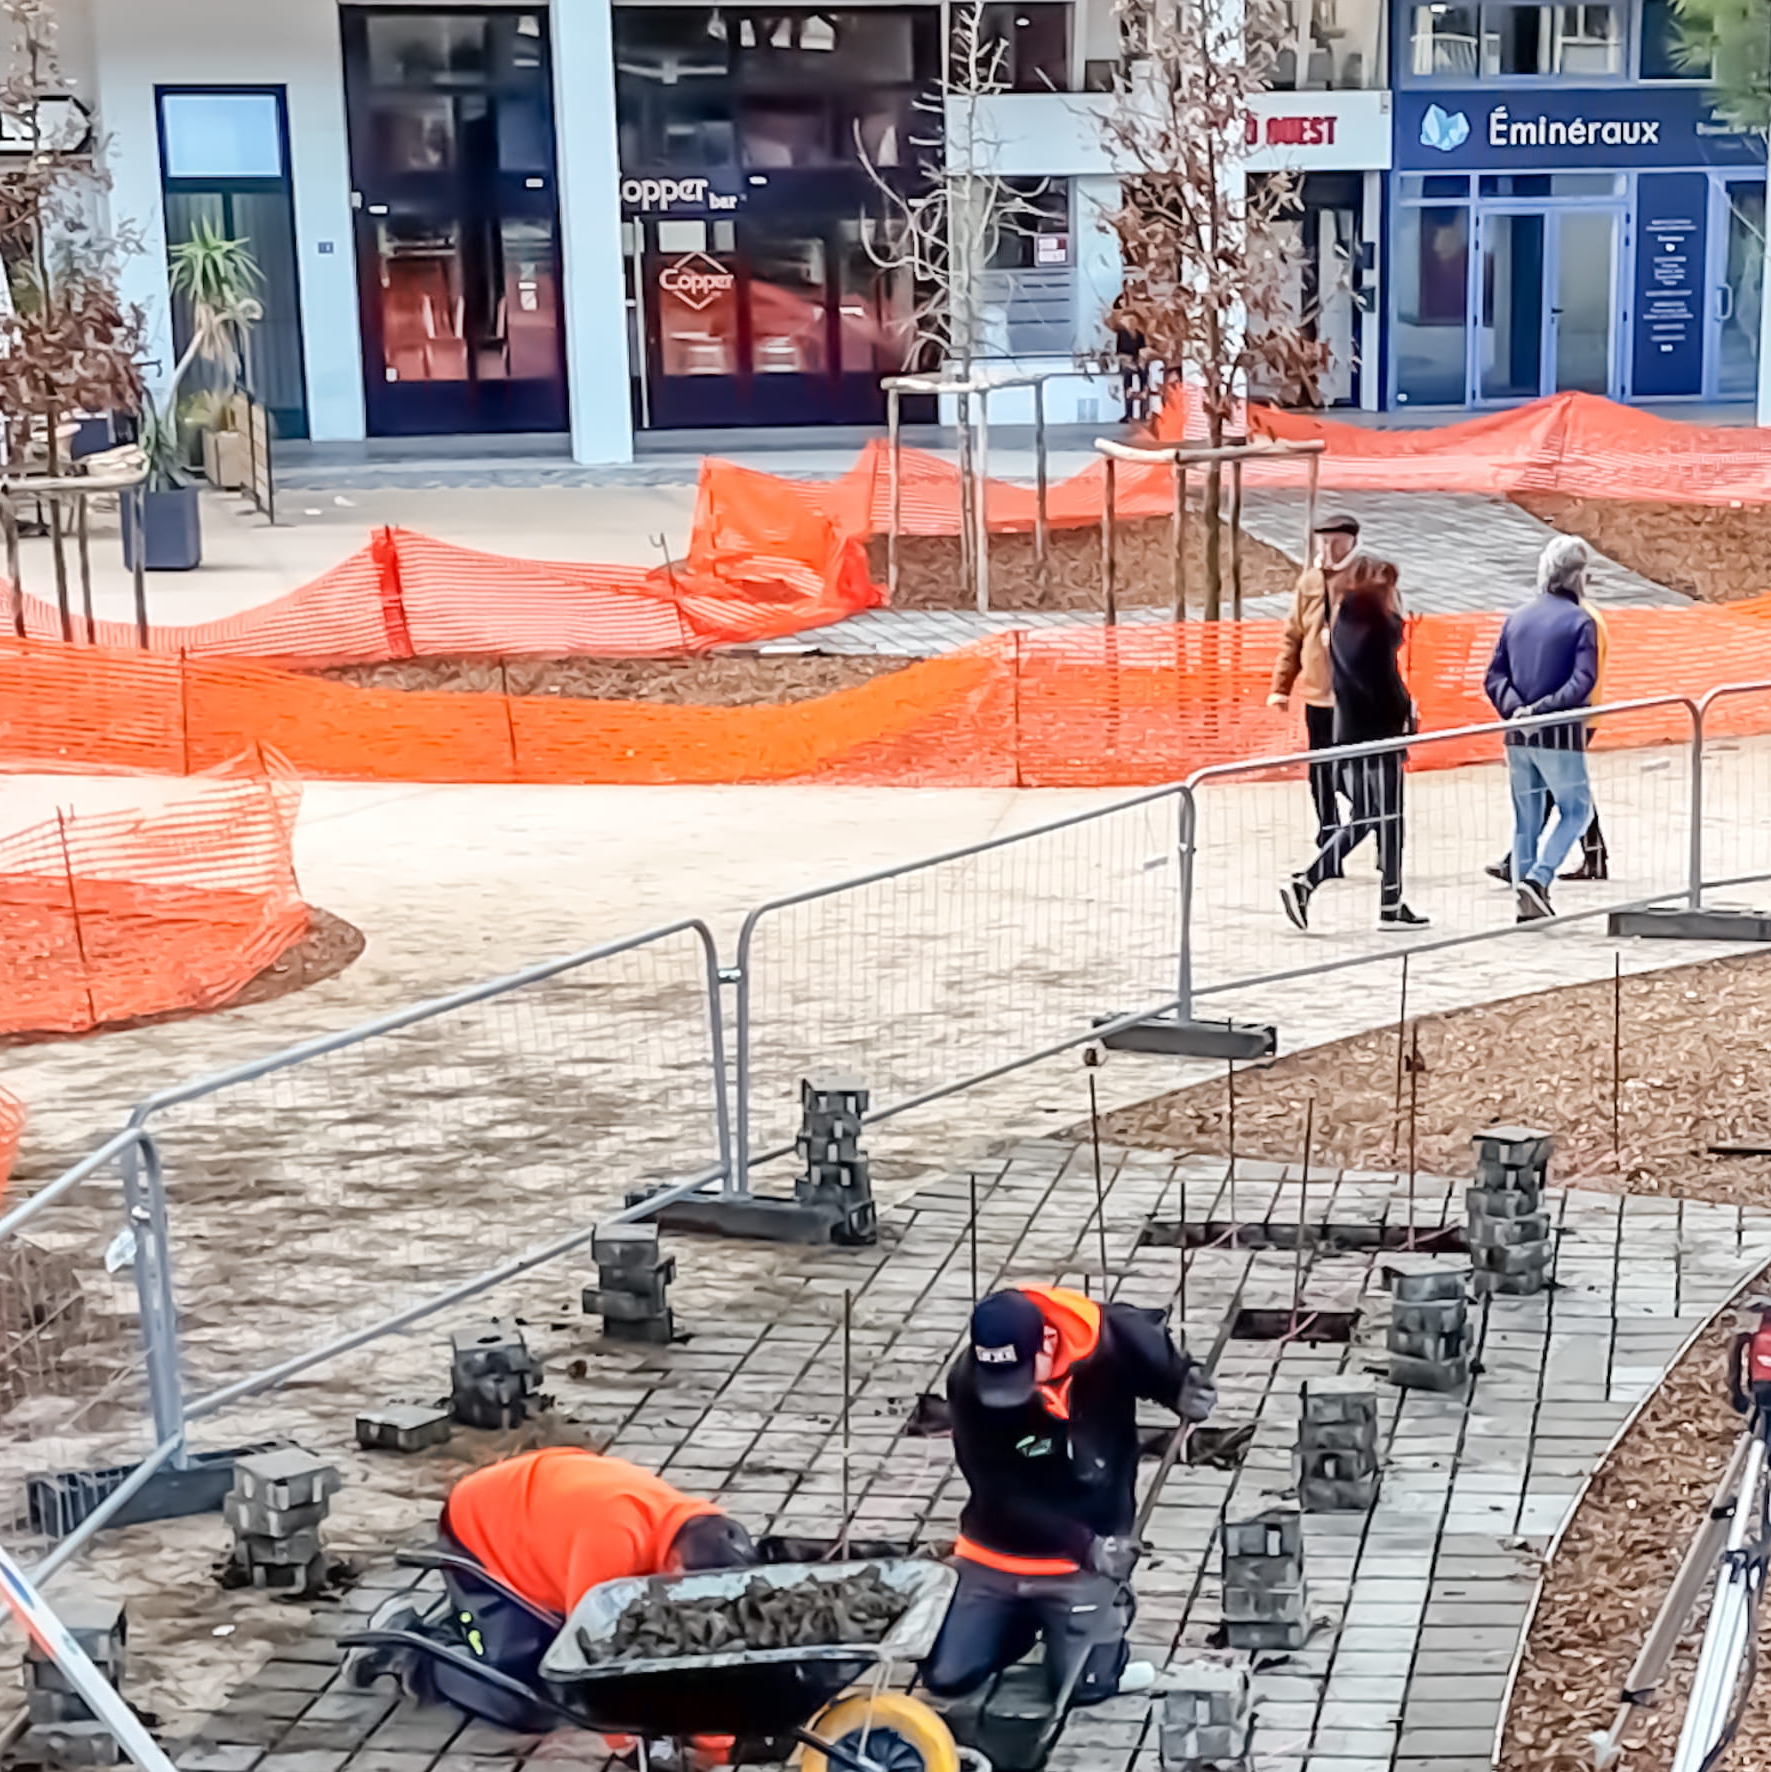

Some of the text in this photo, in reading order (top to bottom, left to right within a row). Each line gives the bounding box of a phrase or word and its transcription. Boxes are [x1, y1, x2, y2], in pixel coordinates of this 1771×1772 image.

[1488, 105, 1661, 146] Éminéraux
[620, 178, 708, 211] opper
[658, 267, 735, 295] Copper
